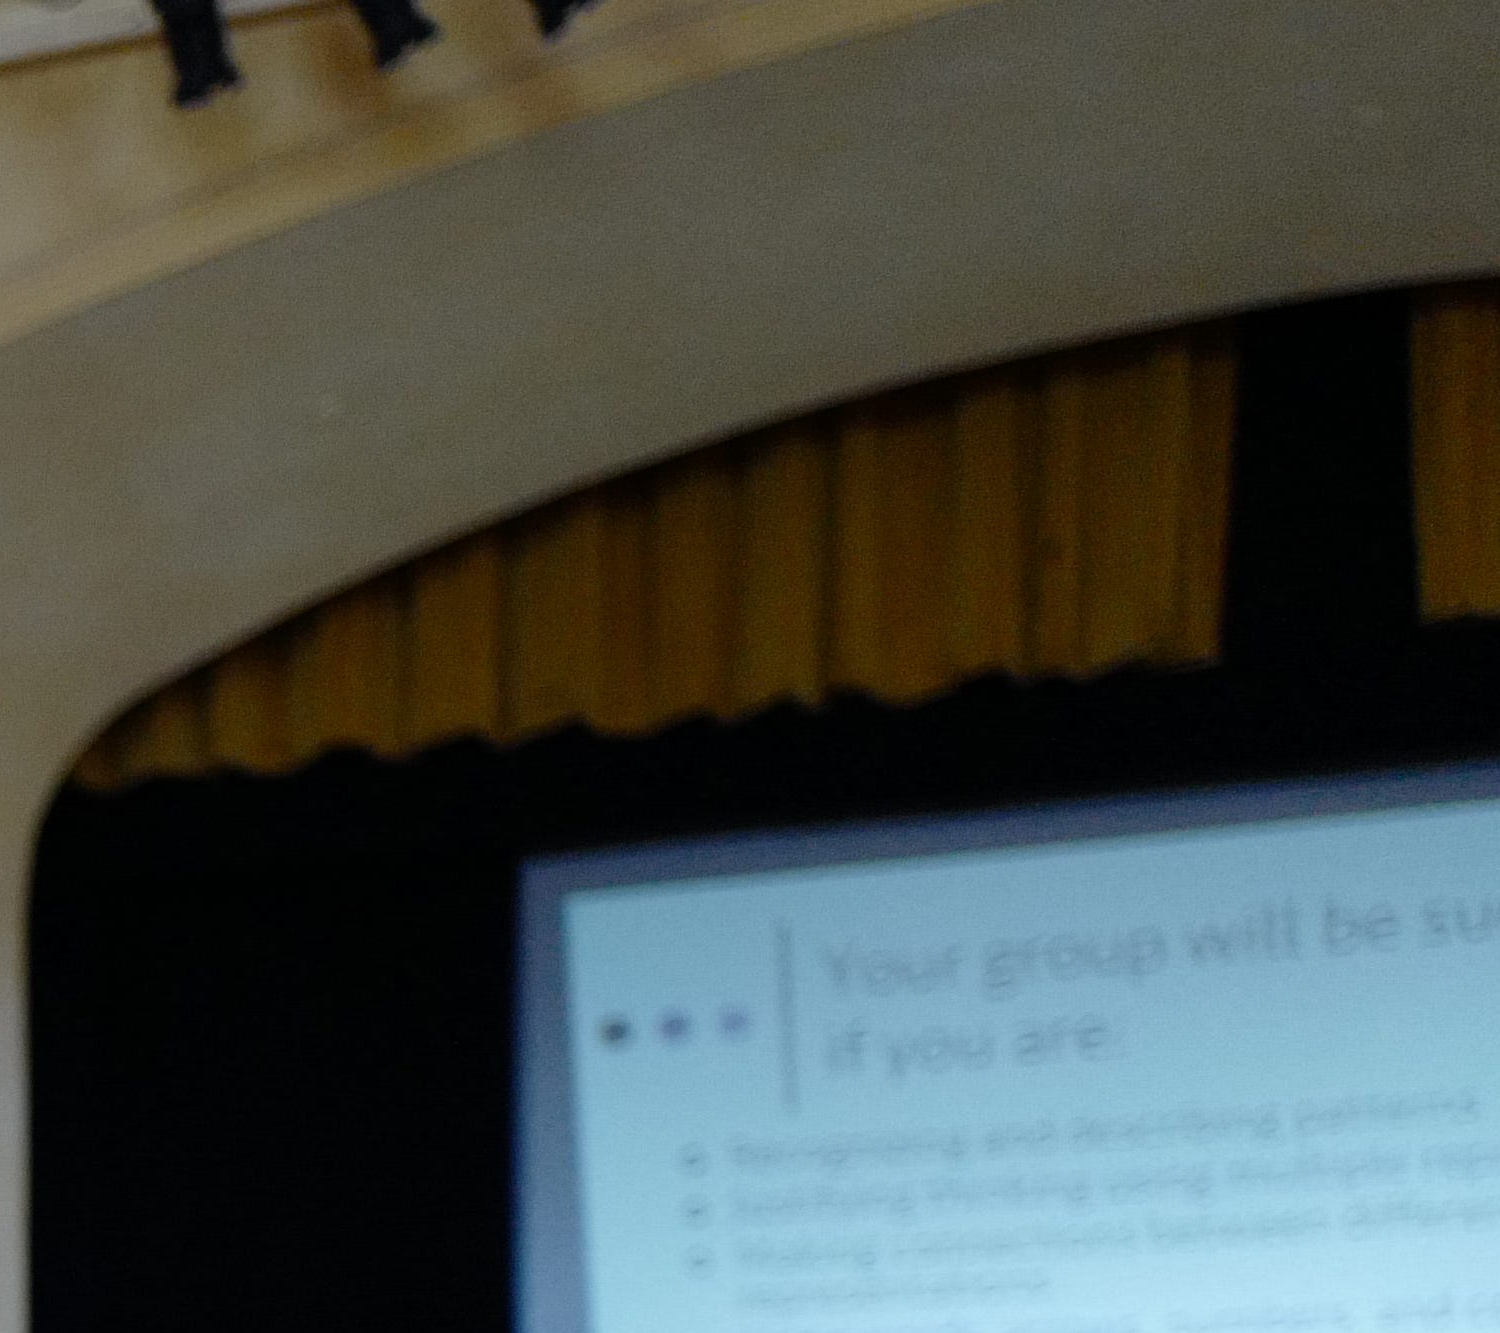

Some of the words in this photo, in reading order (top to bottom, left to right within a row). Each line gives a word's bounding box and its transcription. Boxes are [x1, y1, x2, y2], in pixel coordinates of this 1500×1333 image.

[822, 942, 963, 995] Your
[983, 924, 1169, 996] group
[1187, 900, 1301, 963] will
[1320, 897, 1399, 957] be
[887, 1026, 994, 1076] you
